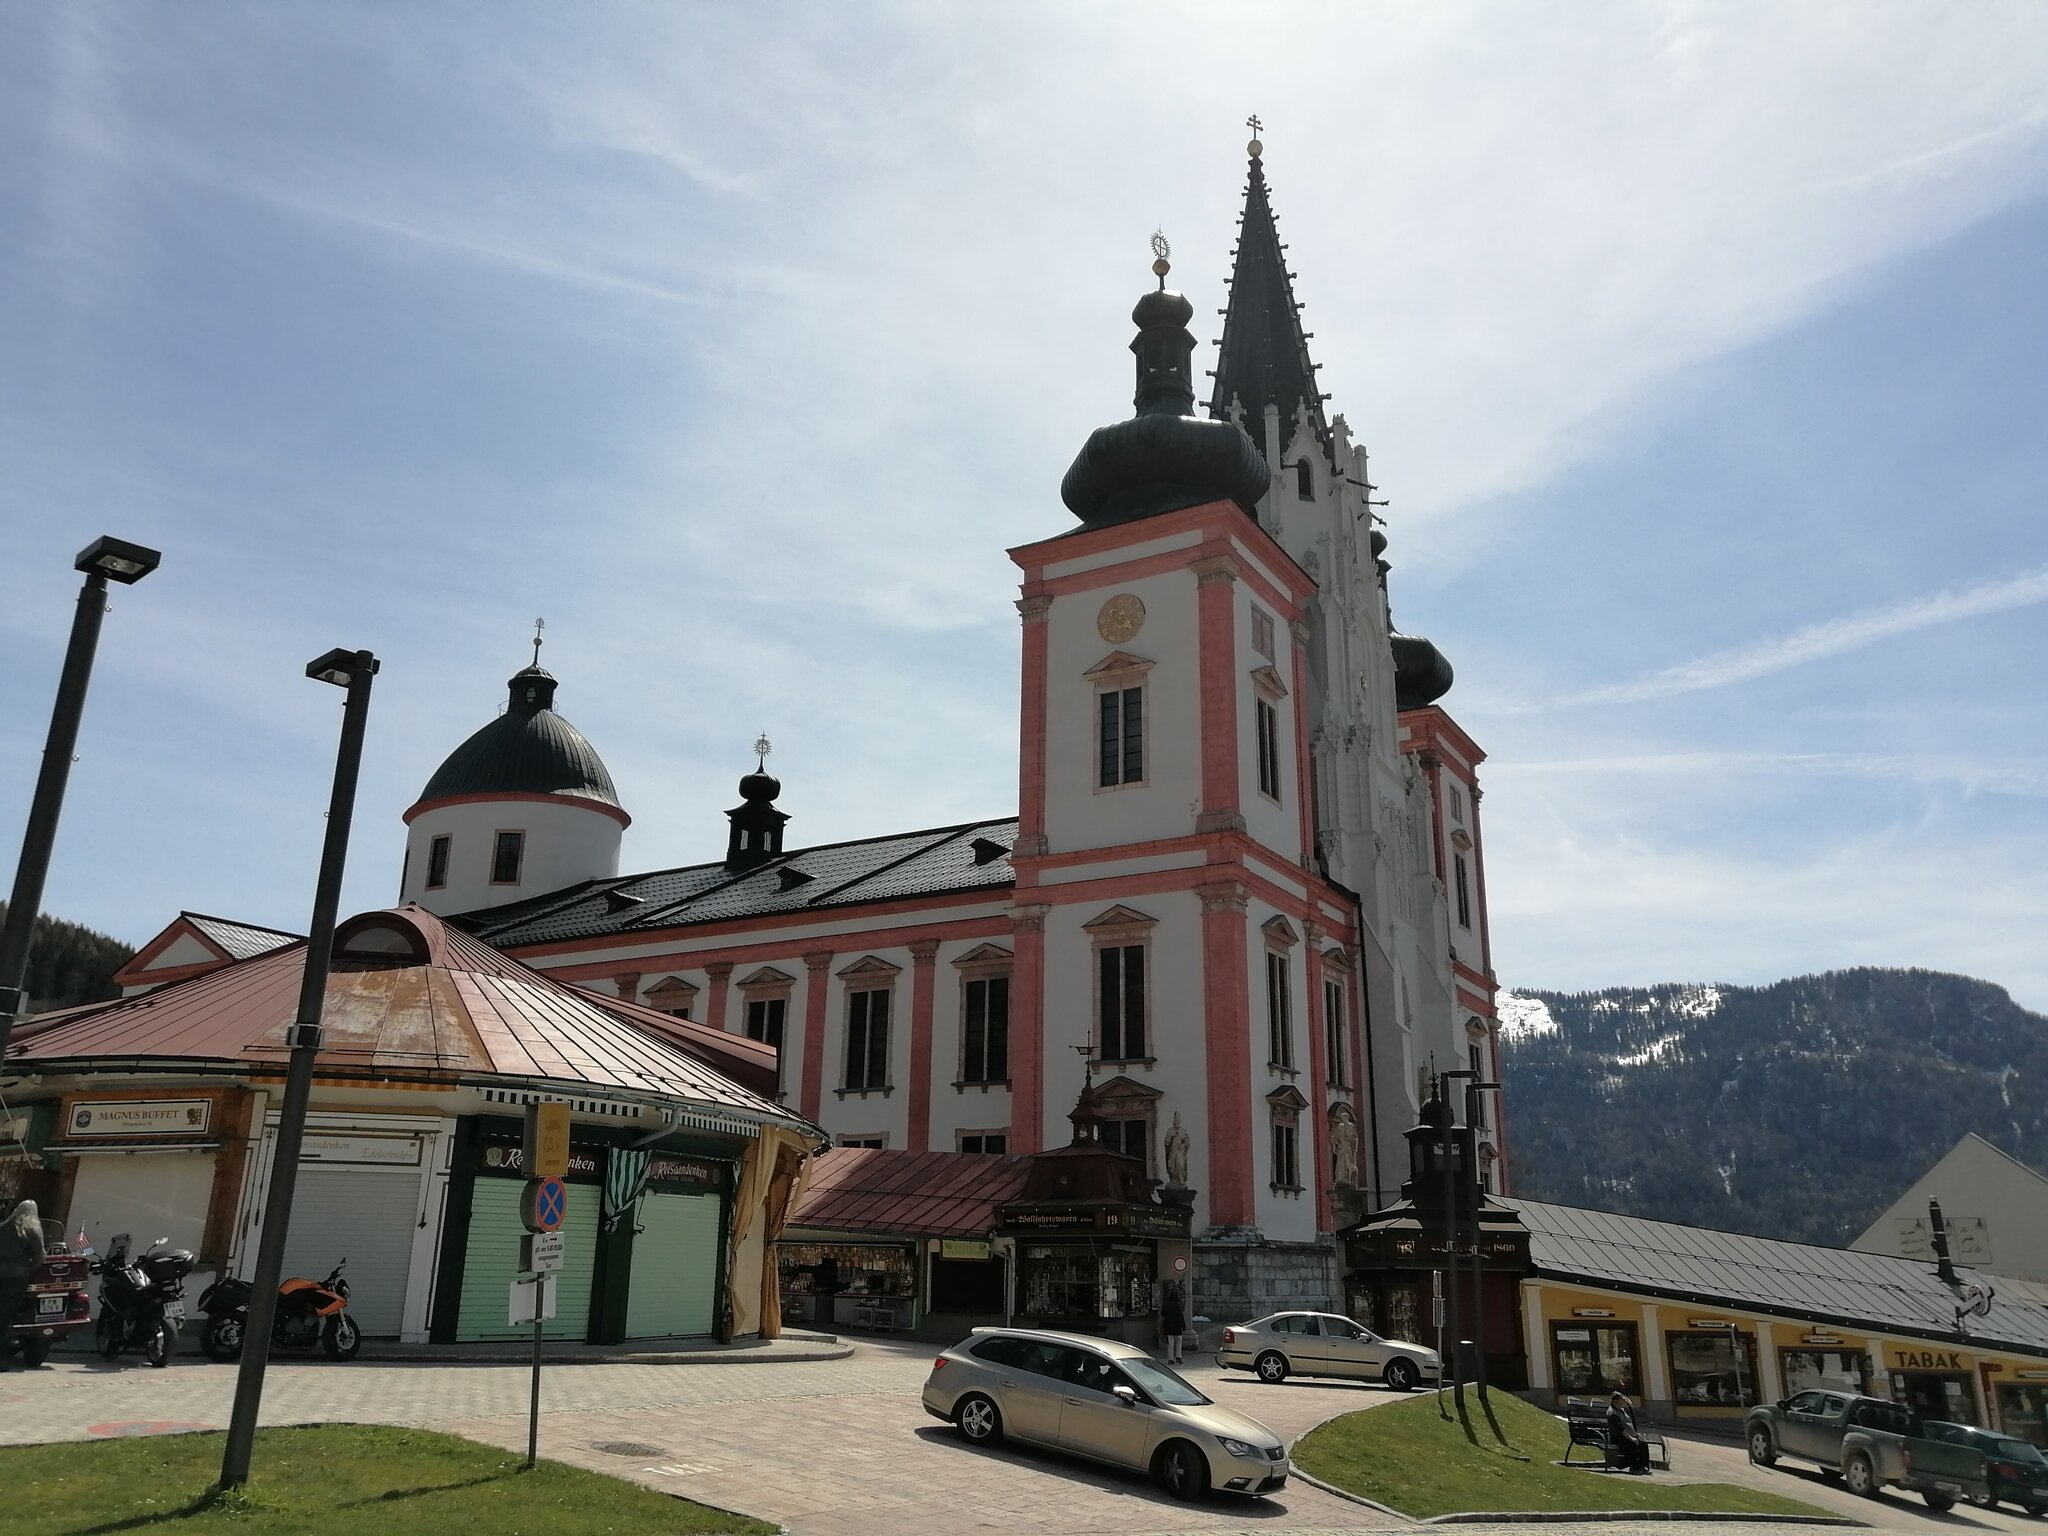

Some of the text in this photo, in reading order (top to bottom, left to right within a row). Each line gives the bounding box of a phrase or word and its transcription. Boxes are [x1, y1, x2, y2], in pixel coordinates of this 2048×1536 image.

[98, 1110, 179, 1121] MAGNUS BUFFET
[1106, 1214, 1118, 1226] 19
[1894, 1351, 1962, 1369] TABAK
